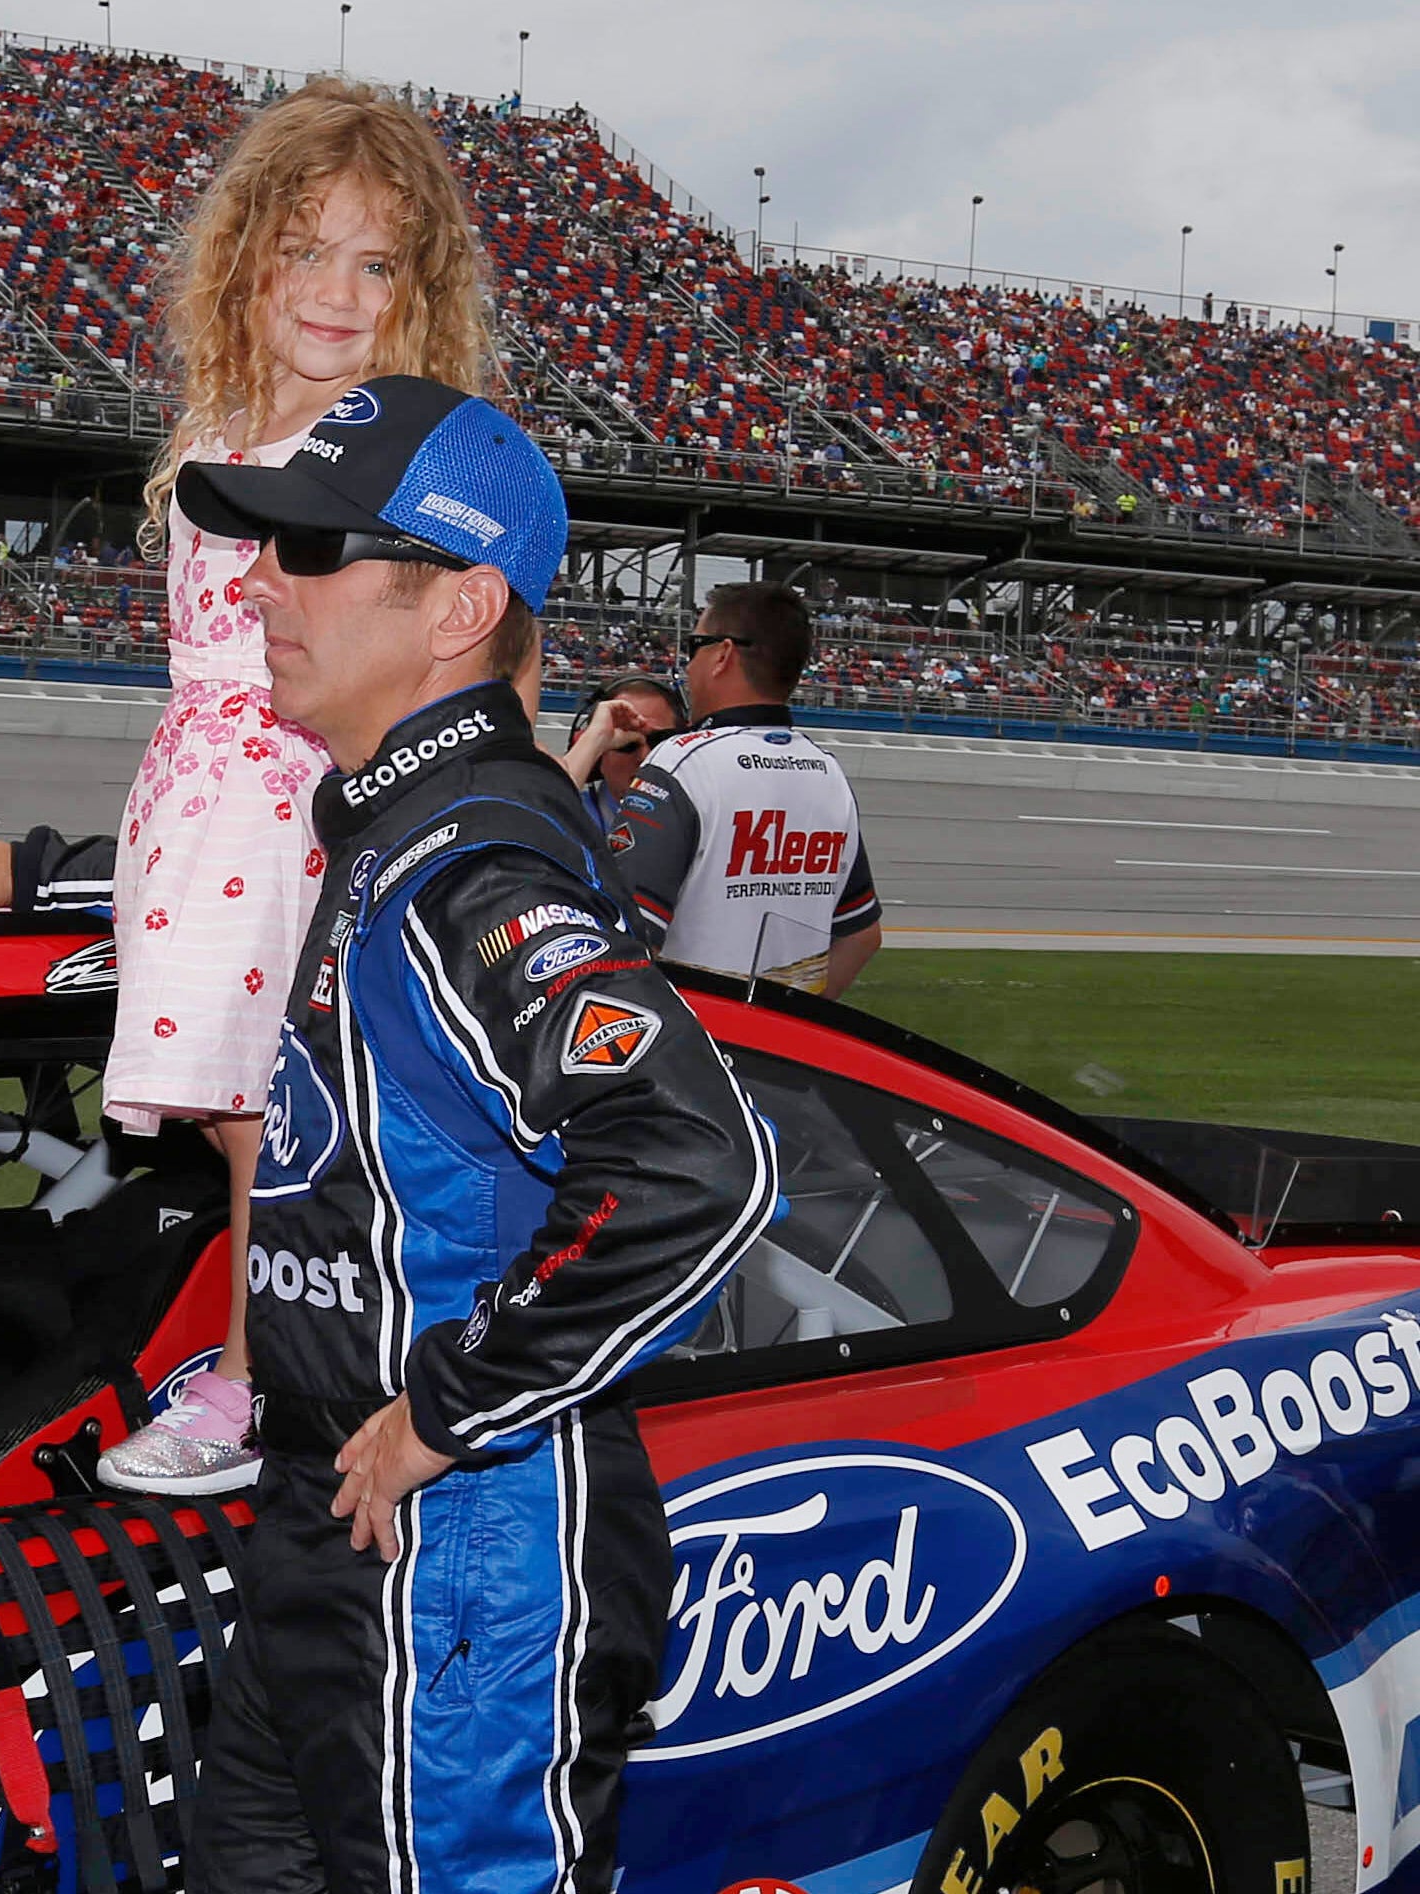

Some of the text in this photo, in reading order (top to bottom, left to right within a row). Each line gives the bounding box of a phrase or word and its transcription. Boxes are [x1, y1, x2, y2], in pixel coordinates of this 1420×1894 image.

[420, 492, 508, 539] ROUSH FENWAY
[435, 513, 478, 536] RACING
[342, 709, 496, 808] EcoBoost
[737, 754, 828, 774] @RoushFenway
[378, 827, 451, 894] SIMPSON
[725, 810, 848, 877] Kleer
[518, 904, 602, 940] NASCAR
[542, 941, 592, 971] Ford
[513, 959, 652, 1032] FORD PERFORMANCE
[570, 1018, 647, 1063] INTERNATIONAL
[1025, 1312, 1420, 1552] EcoBoost
[640, 1493, 937, 1730] Ford
